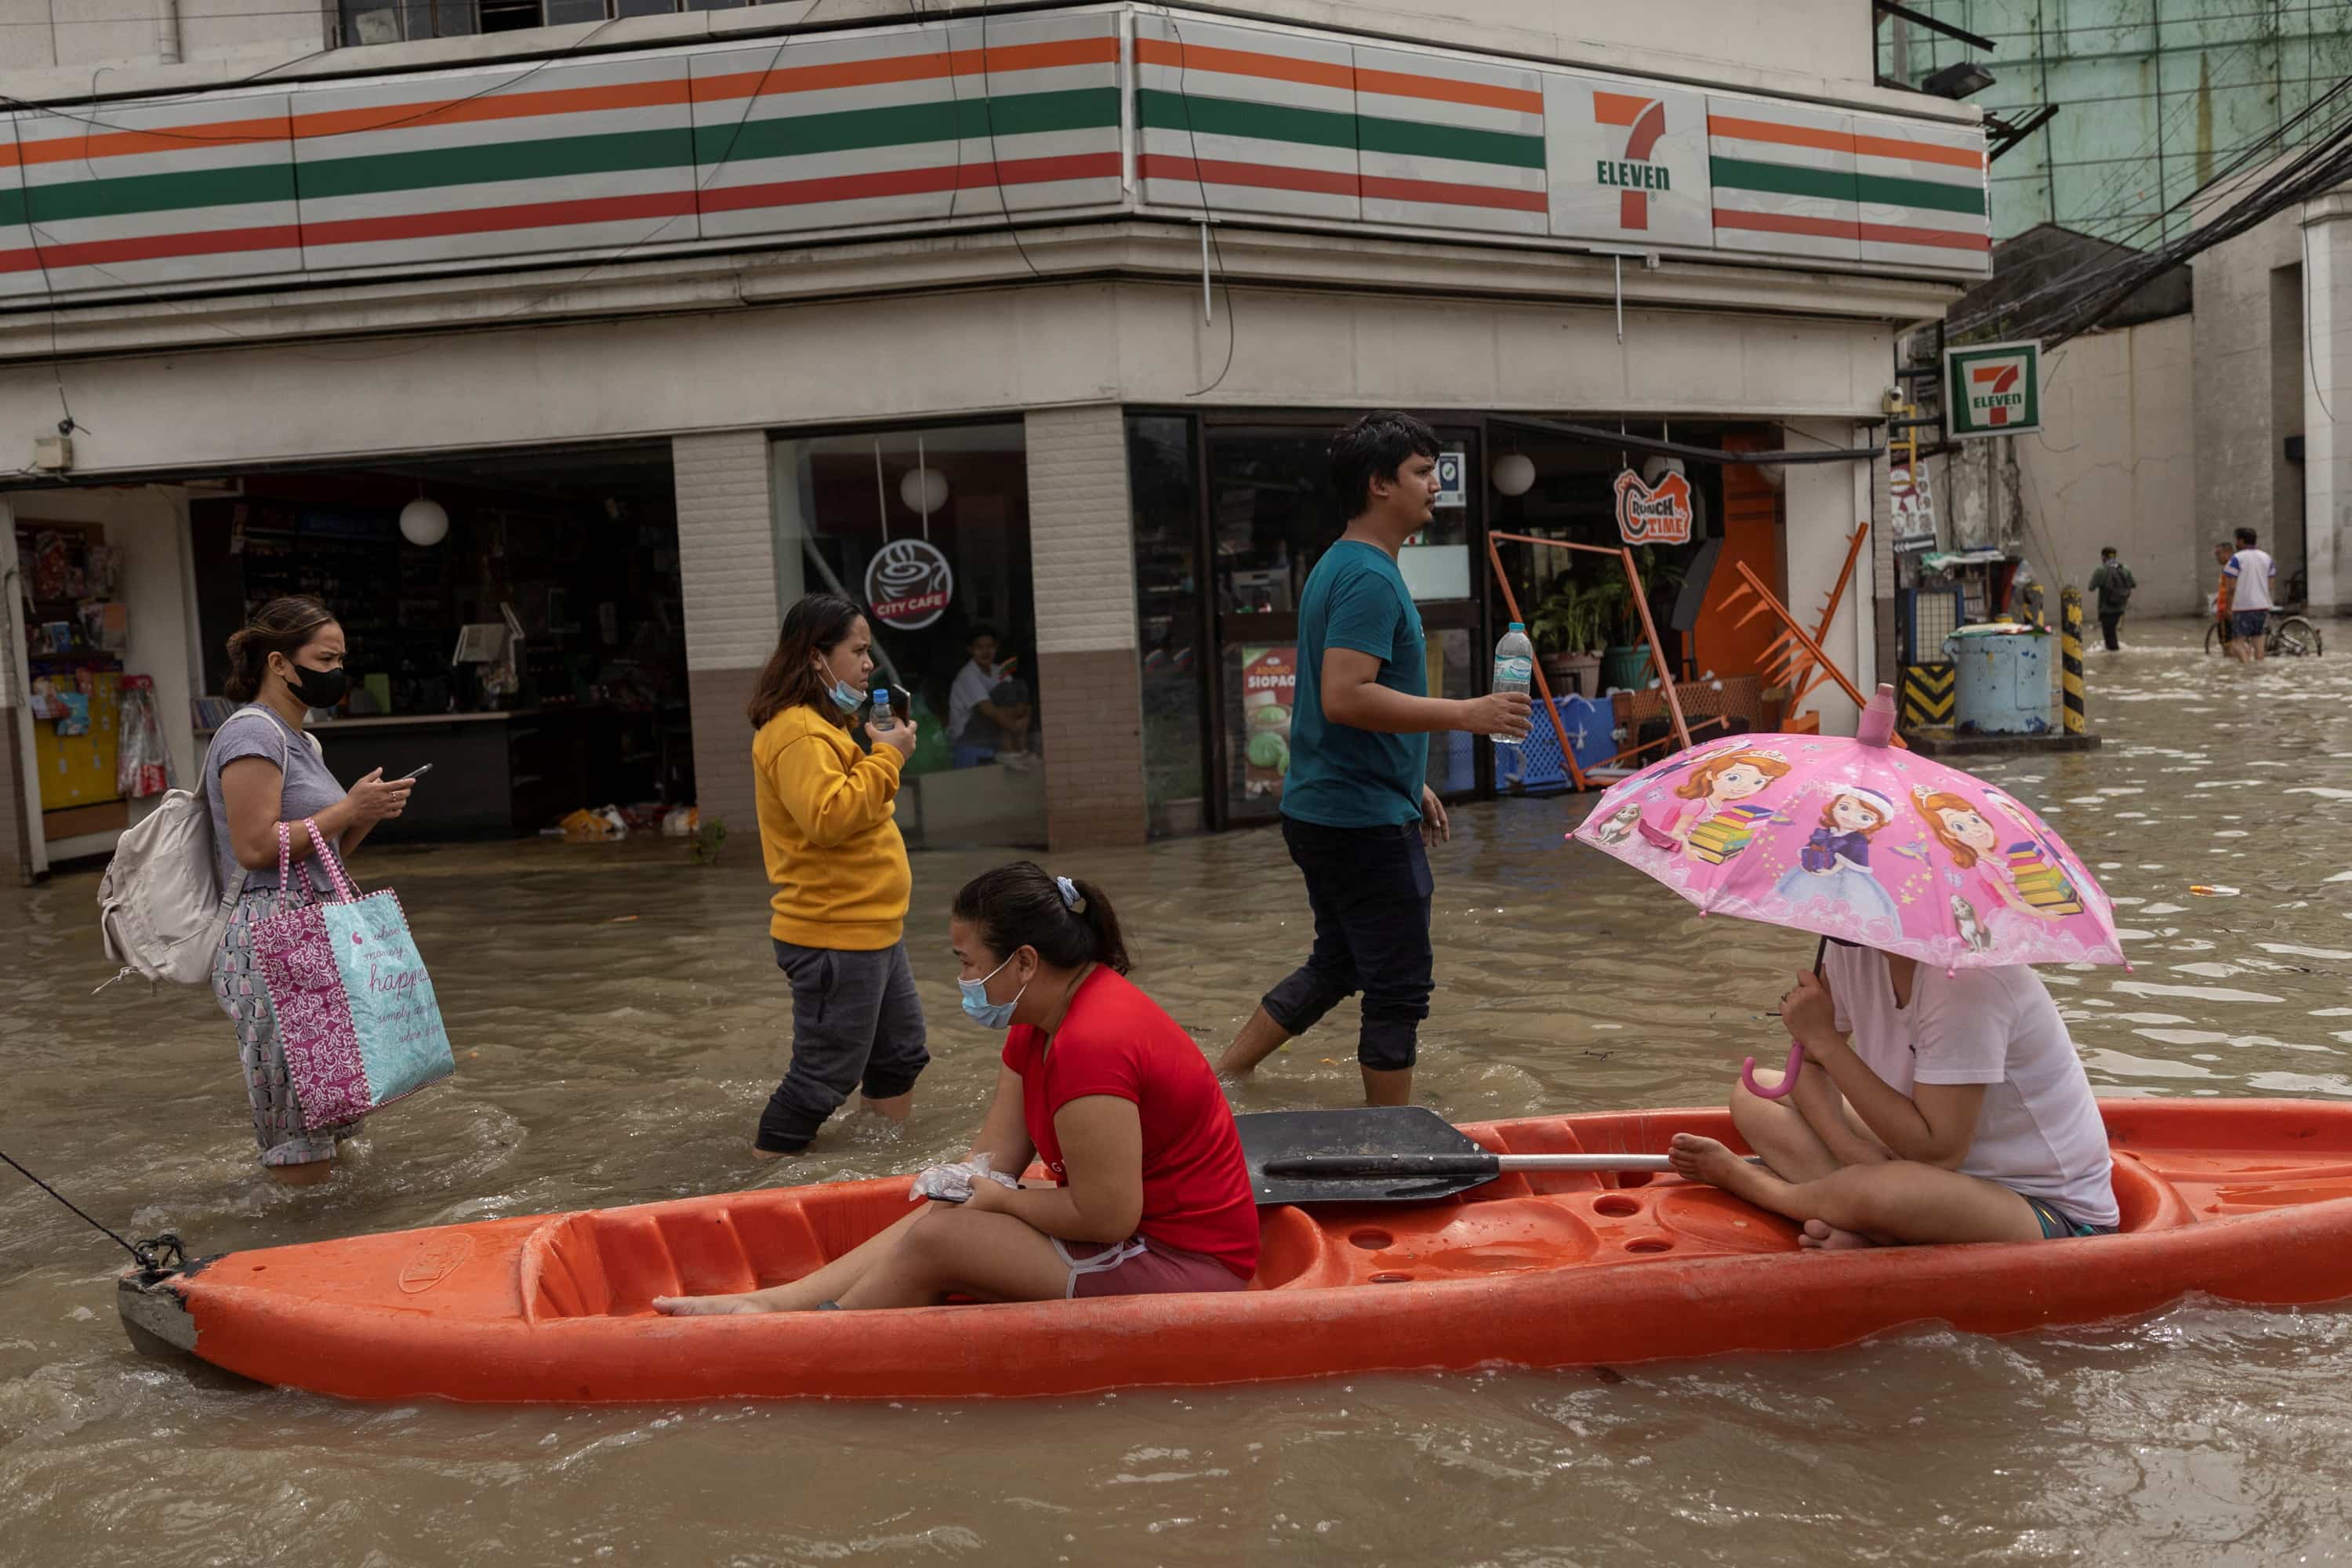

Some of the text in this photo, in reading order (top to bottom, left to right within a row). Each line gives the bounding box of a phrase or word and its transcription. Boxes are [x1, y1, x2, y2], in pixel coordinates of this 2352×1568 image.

[1593, 91, 1665, 230] 7
[1973, 363, 2018, 424] 7
[1647, 517, 1683, 534] TIME
[877, 593, 942, 615] CITY CAFE
